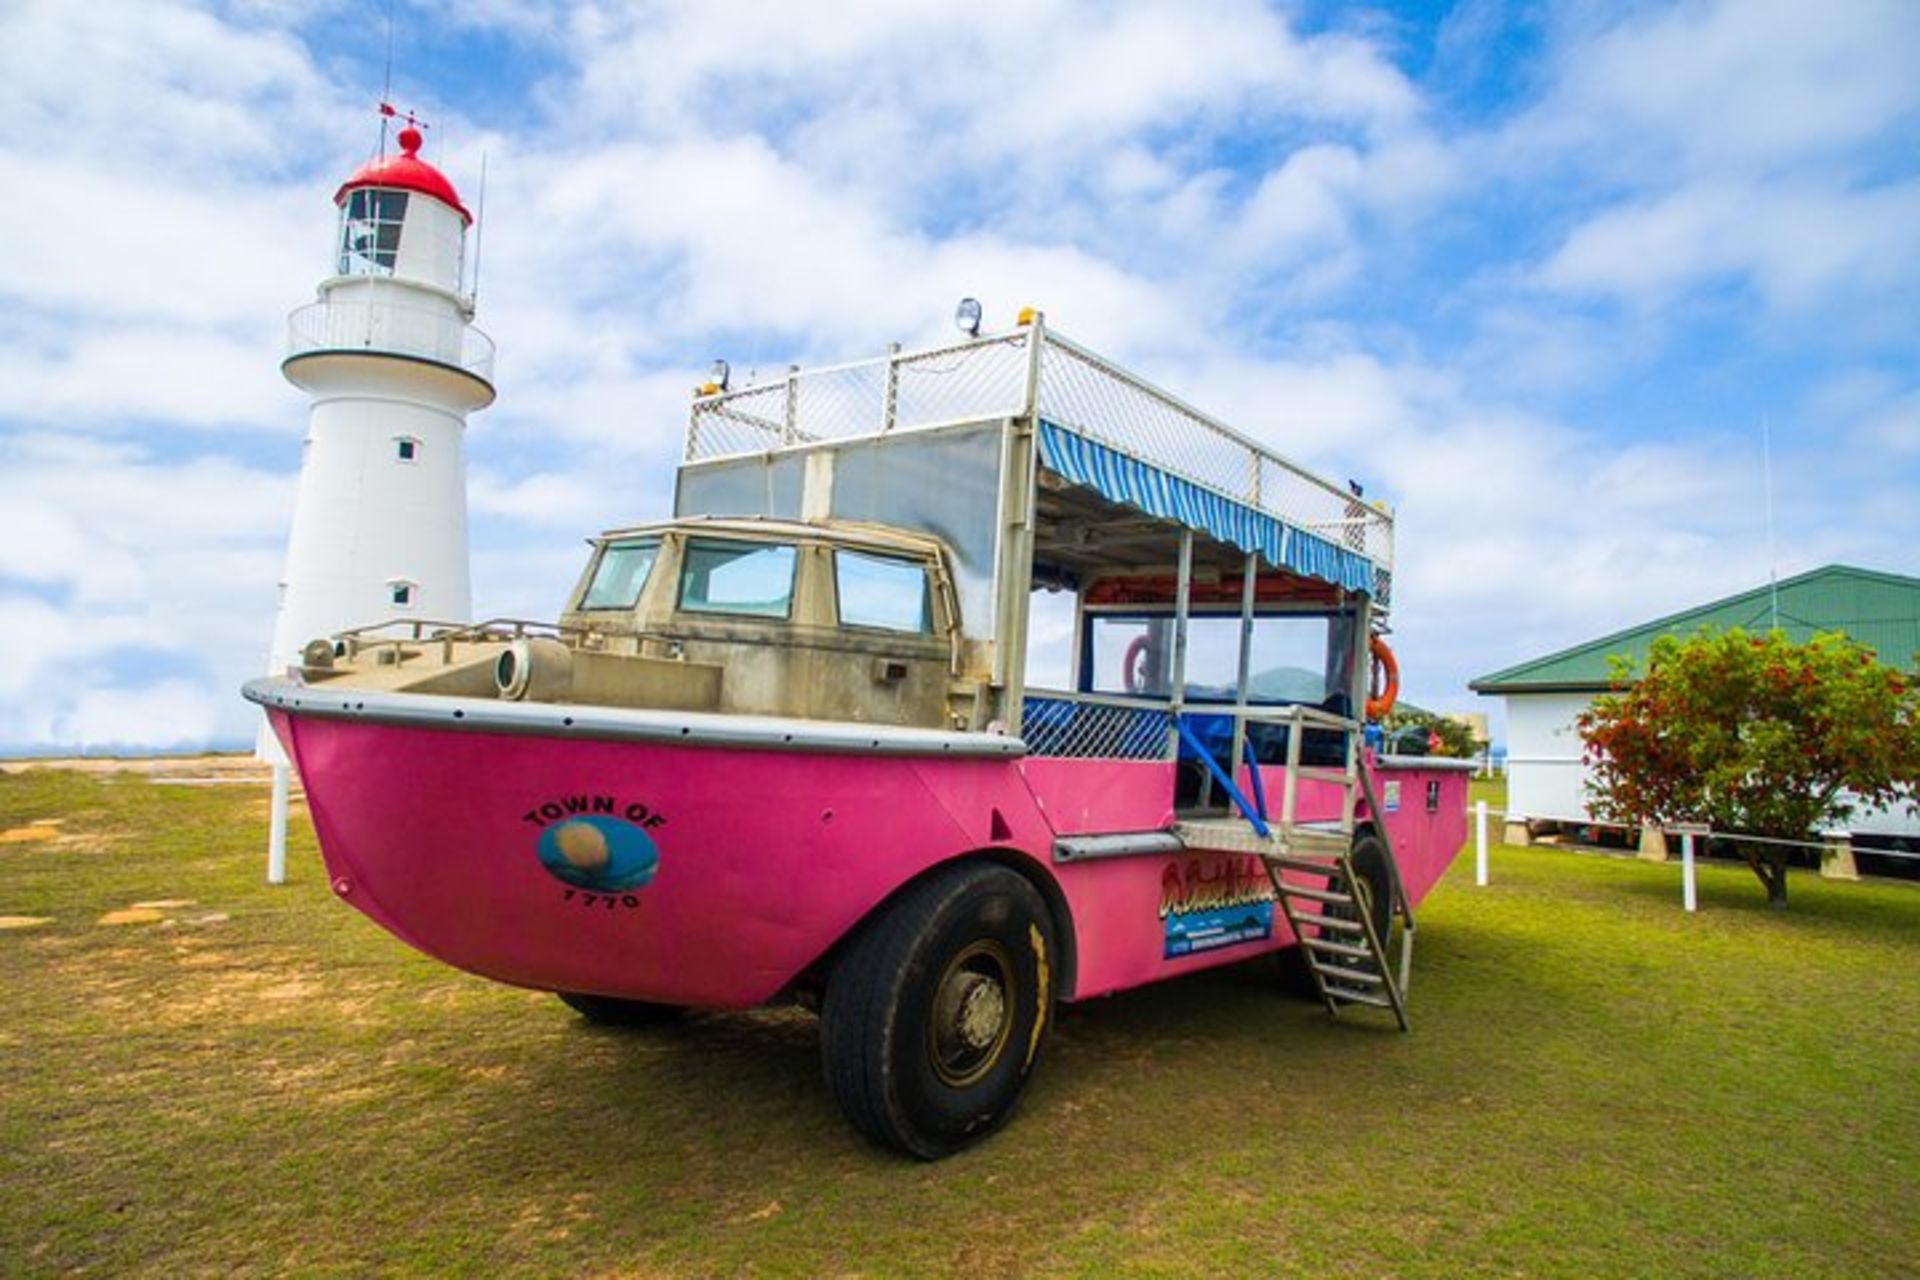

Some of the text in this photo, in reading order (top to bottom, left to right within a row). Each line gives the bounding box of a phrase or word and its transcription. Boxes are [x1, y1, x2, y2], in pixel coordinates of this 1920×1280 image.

[523, 794, 667, 828] TOWN OF
[564, 889, 640, 910] 1770
